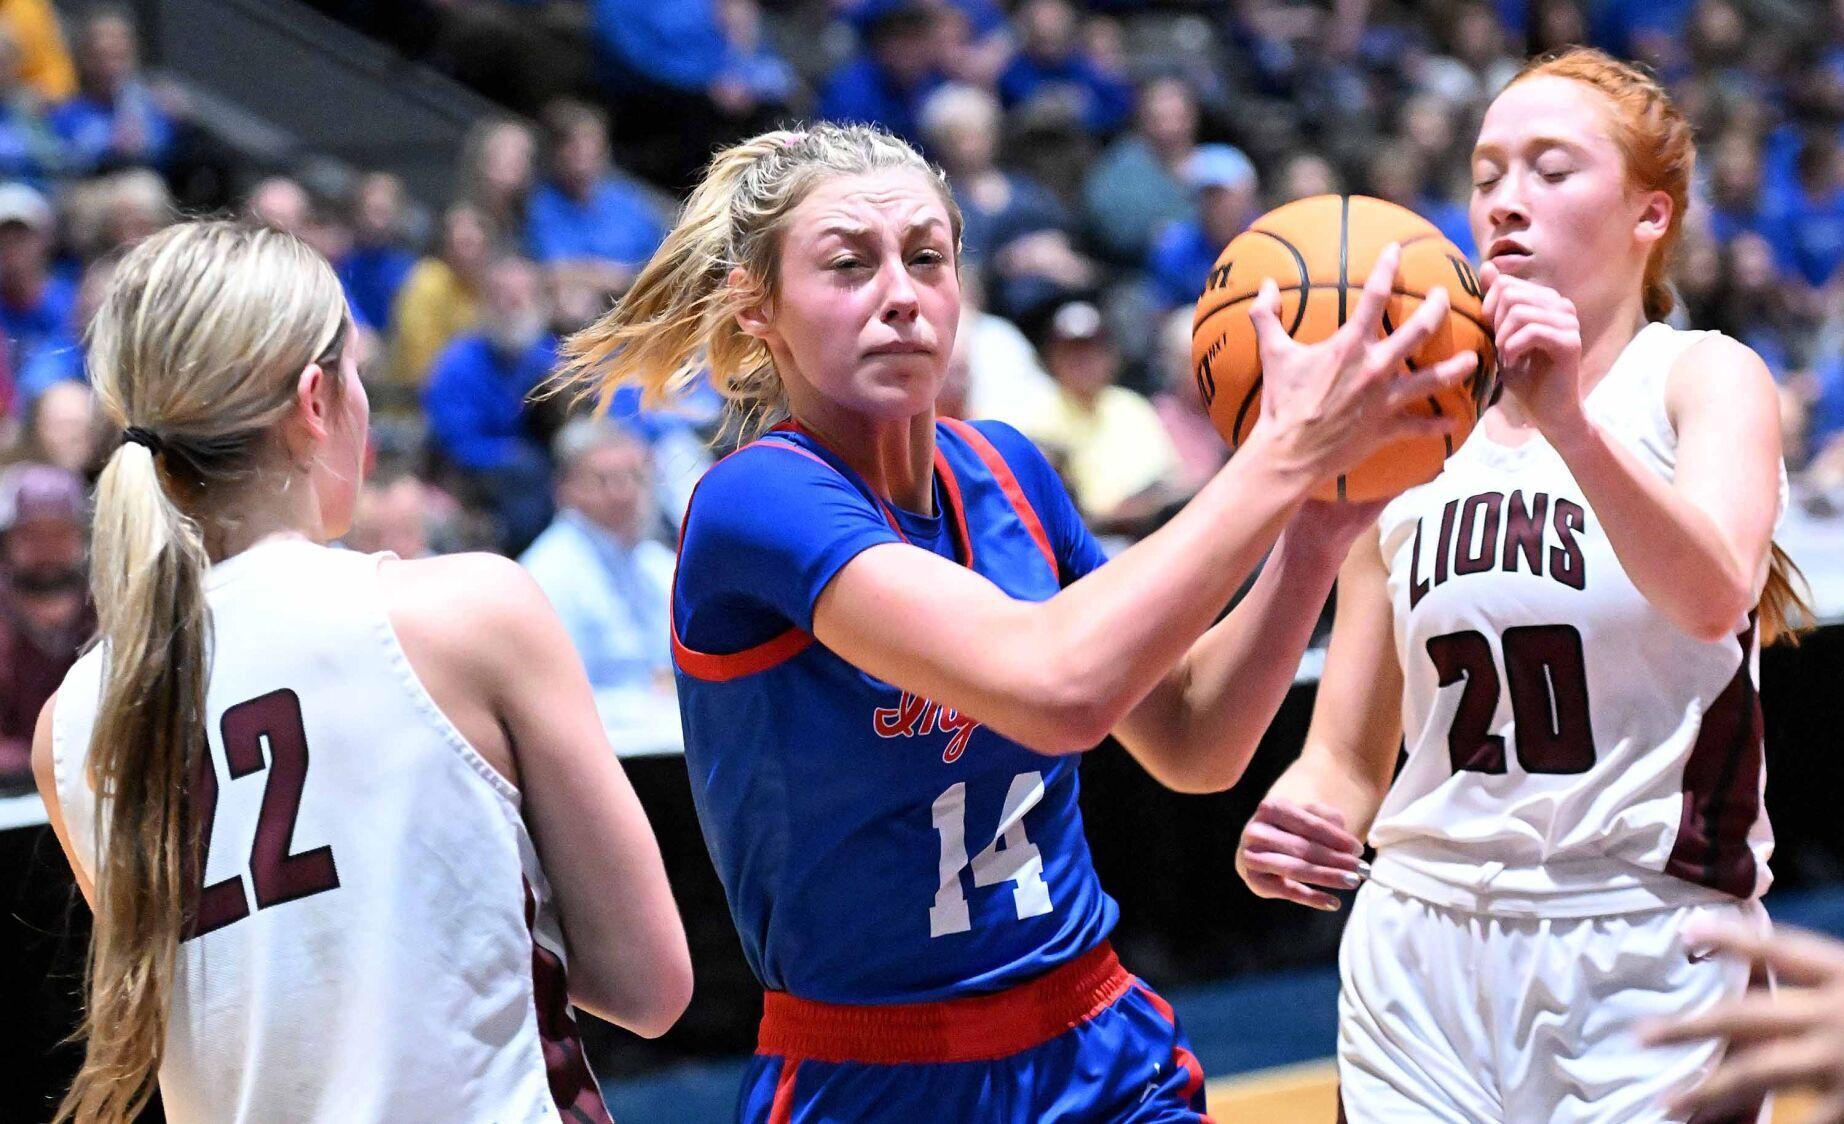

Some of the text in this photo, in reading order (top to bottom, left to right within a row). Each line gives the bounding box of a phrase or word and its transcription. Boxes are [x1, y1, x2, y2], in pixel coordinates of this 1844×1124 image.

[1410, 489, 1586, 612] LIONS
[1426, 624, 1597, 775] 20
[929, 770, 1053, 938] 14
